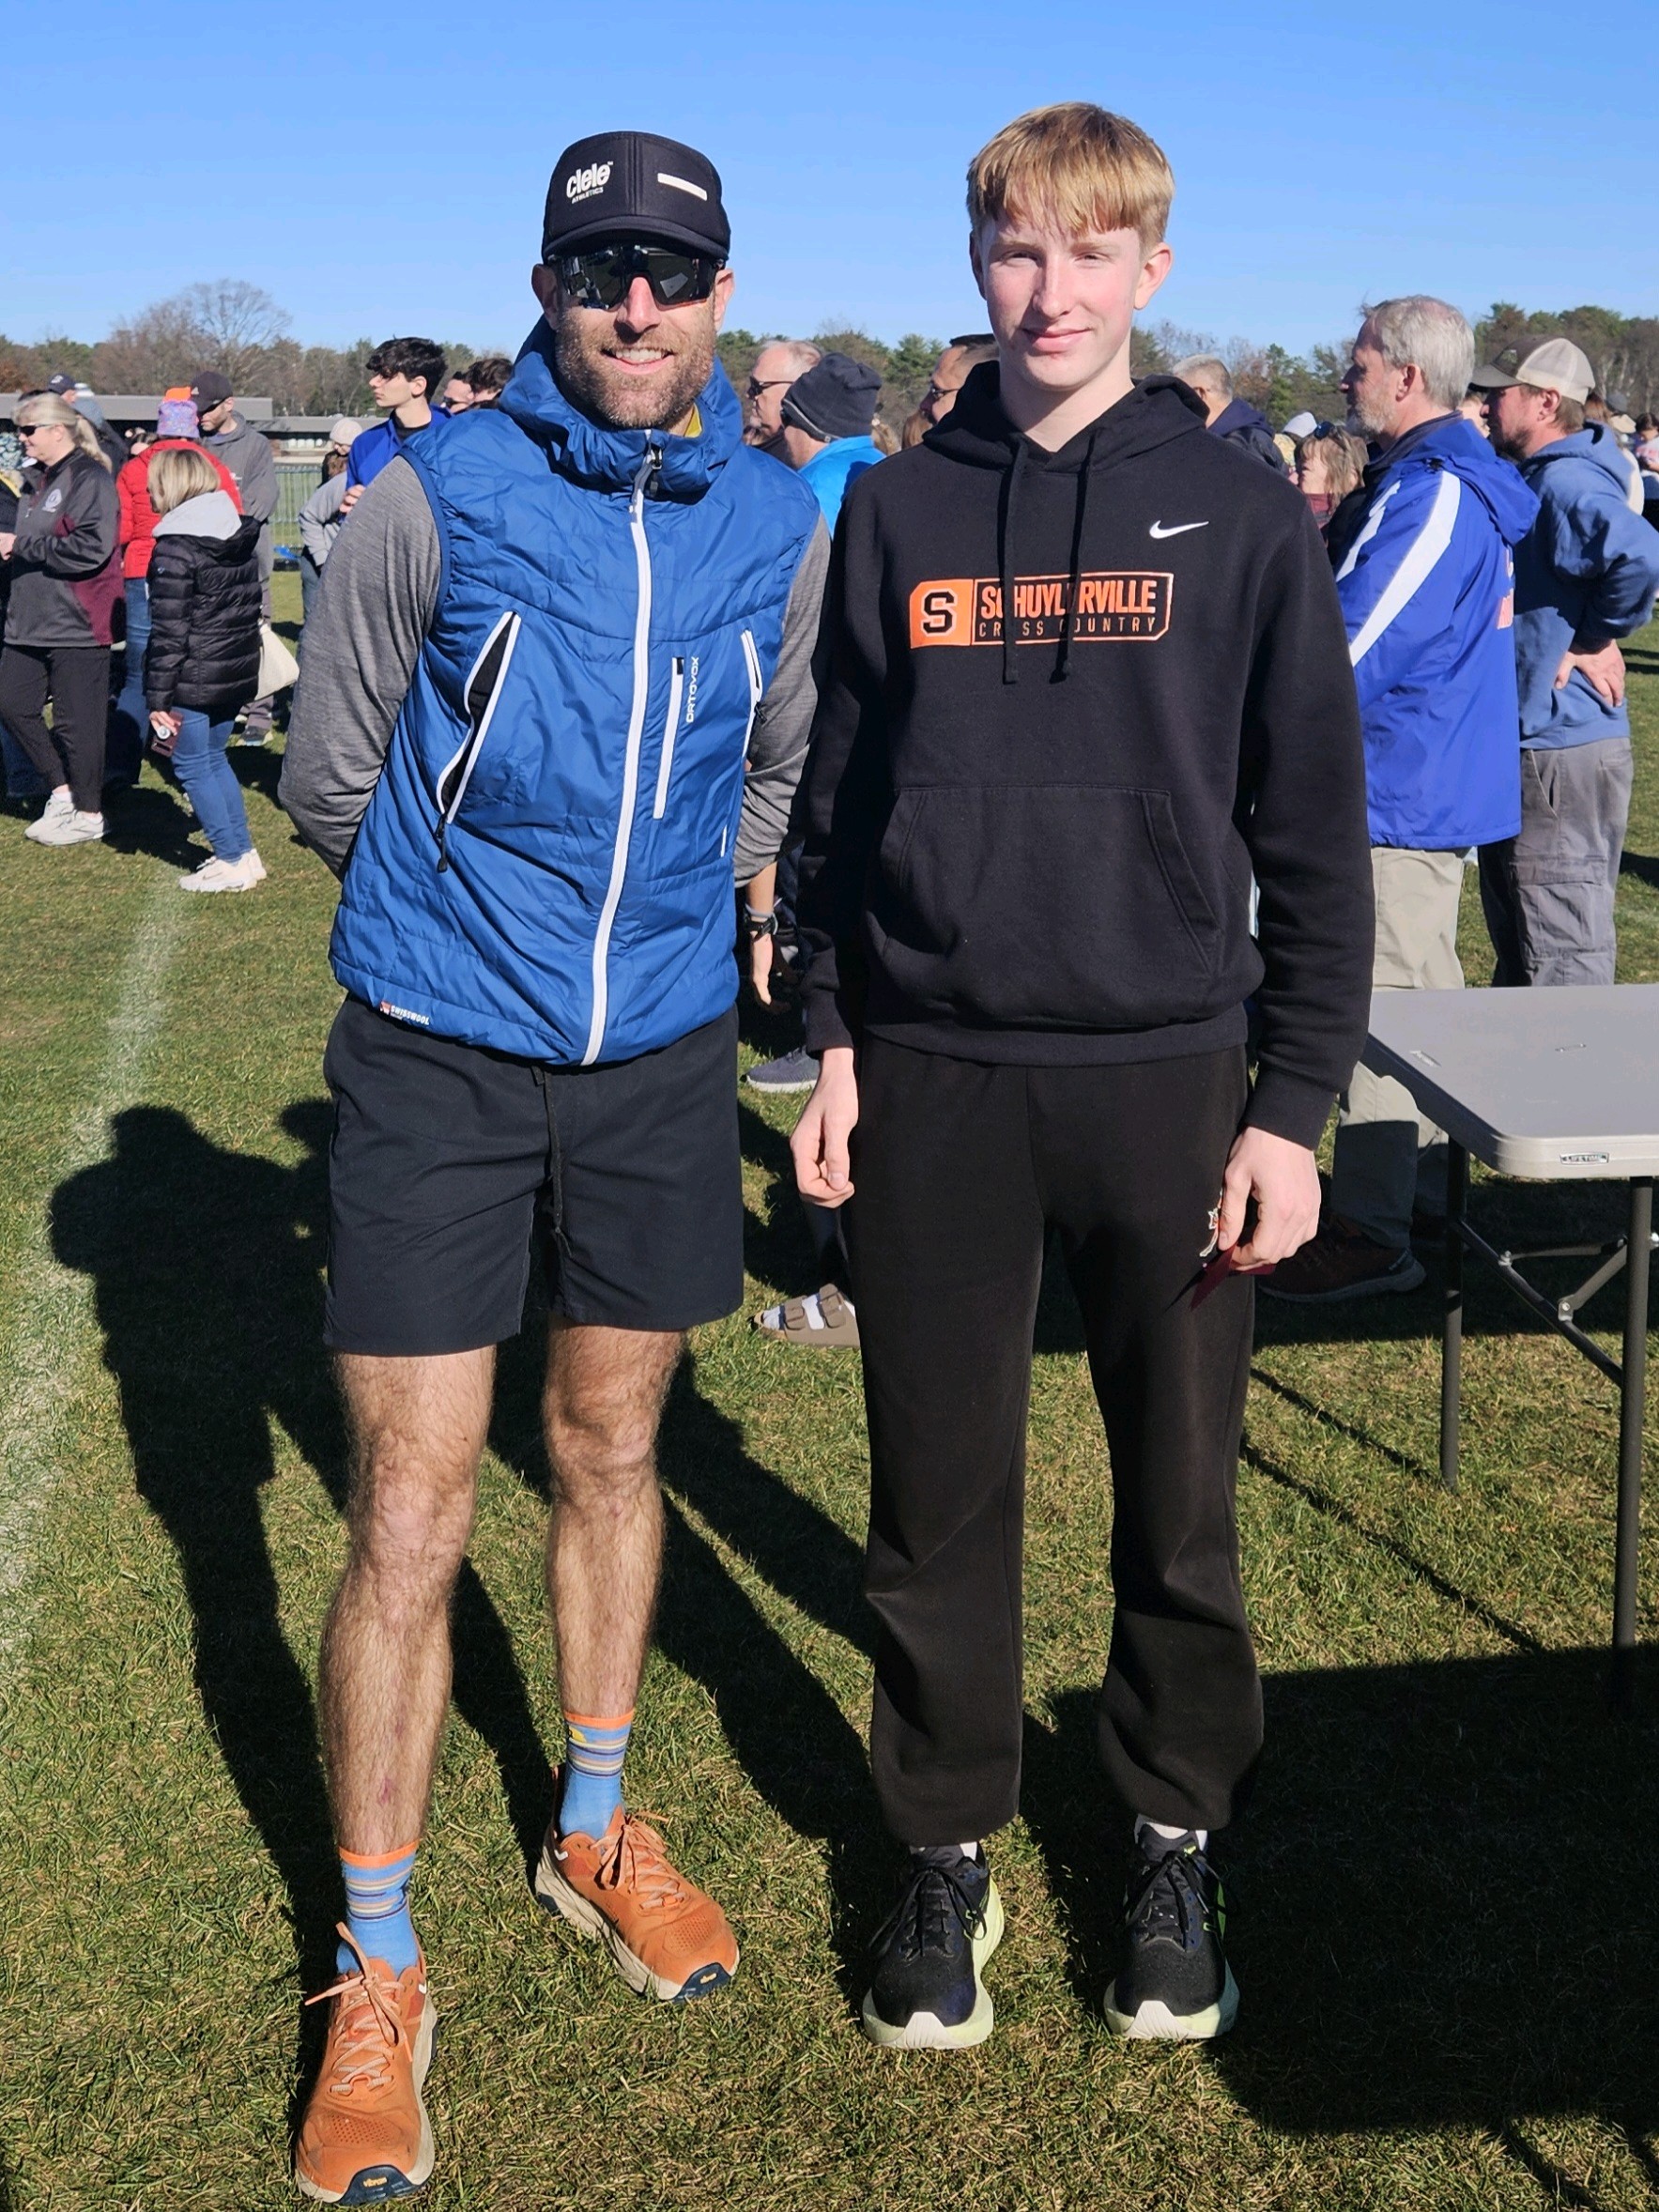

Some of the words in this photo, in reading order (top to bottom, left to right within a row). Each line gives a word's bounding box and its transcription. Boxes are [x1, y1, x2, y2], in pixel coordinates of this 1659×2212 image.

[920, 588, 958, 637] S
[978, 620, 1045, 637] CRSS
[685, 656, 699, 723] ORTOVOX
